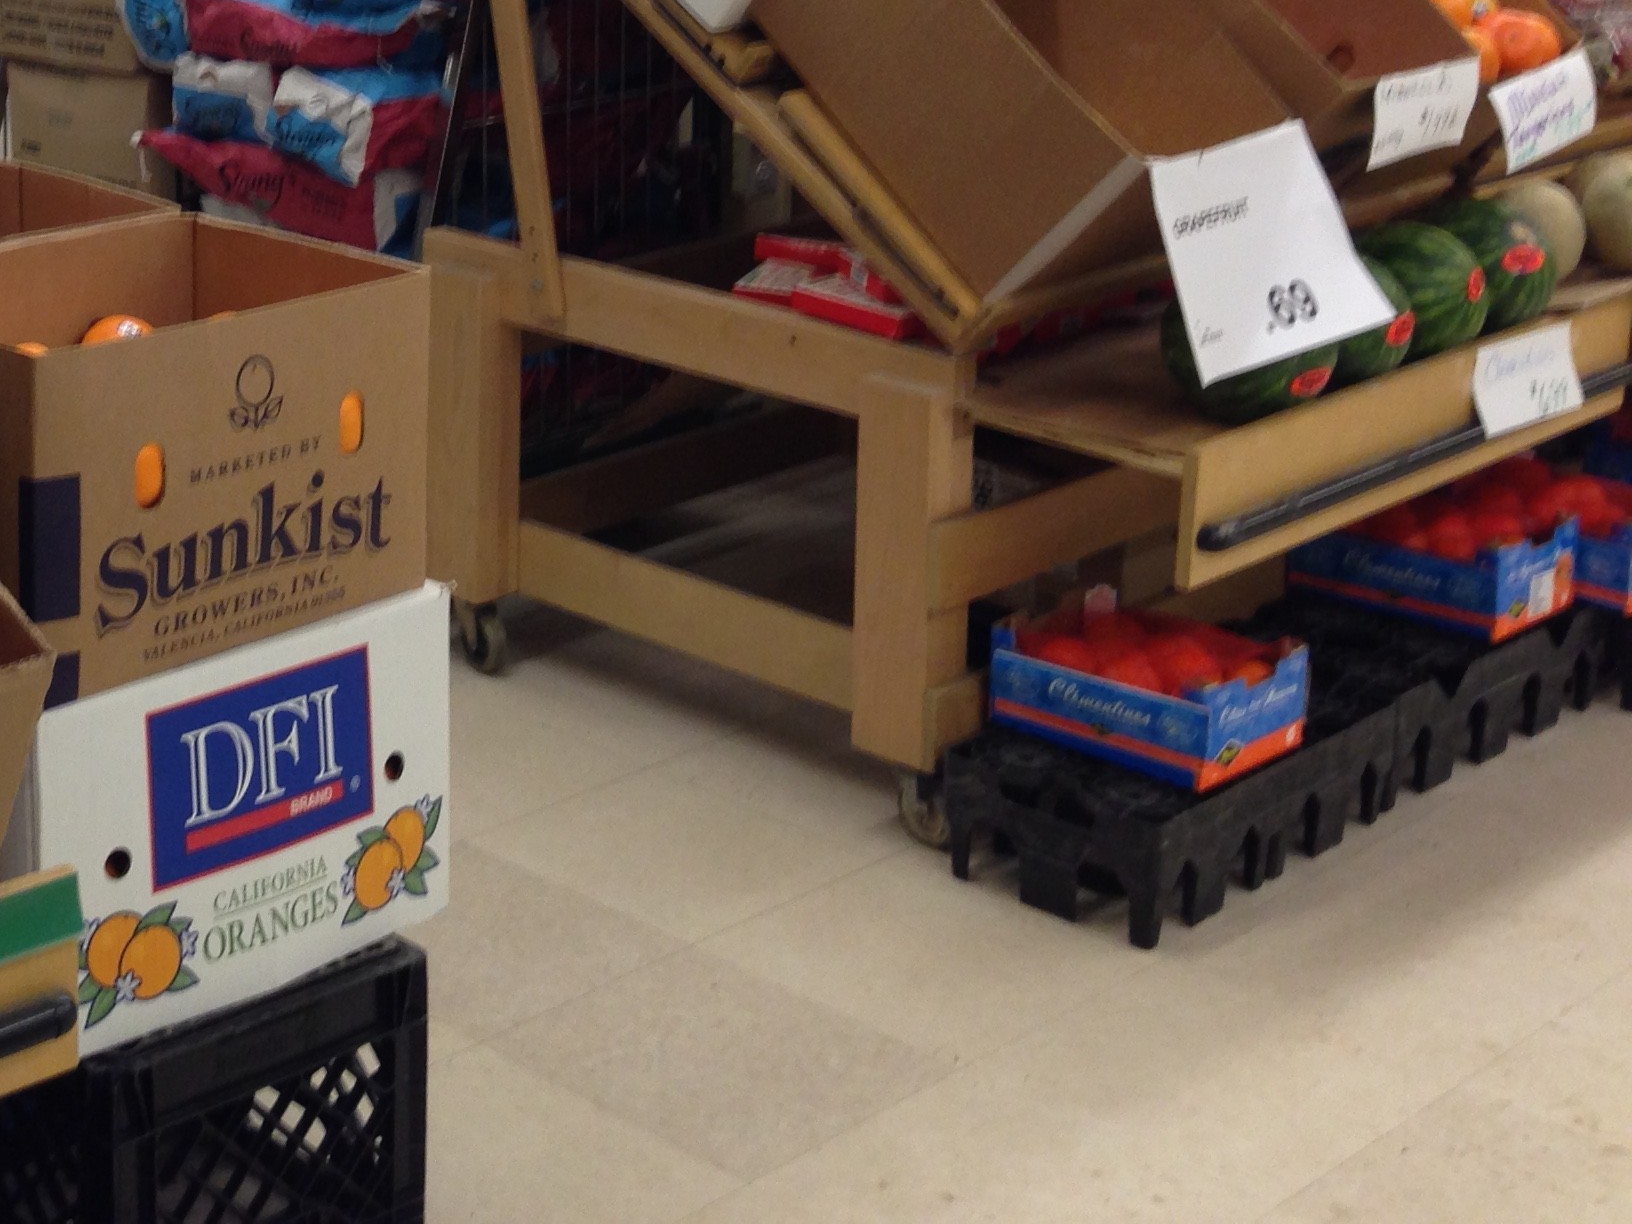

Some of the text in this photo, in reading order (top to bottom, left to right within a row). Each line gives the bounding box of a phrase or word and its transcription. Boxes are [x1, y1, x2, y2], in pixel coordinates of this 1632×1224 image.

[190, 434, 324, 483] MARKETED BY
[95, 468, 392, 639] Sunkist
[153, 564, 340, 637] GROWERS, INC.
[179, 683, 345, 829] DFI
[289, 785, 334, 817] BRAND
[212, 855, 329, 911] CALIFORNIA
[202, 882, 340, 963] ORANGES
